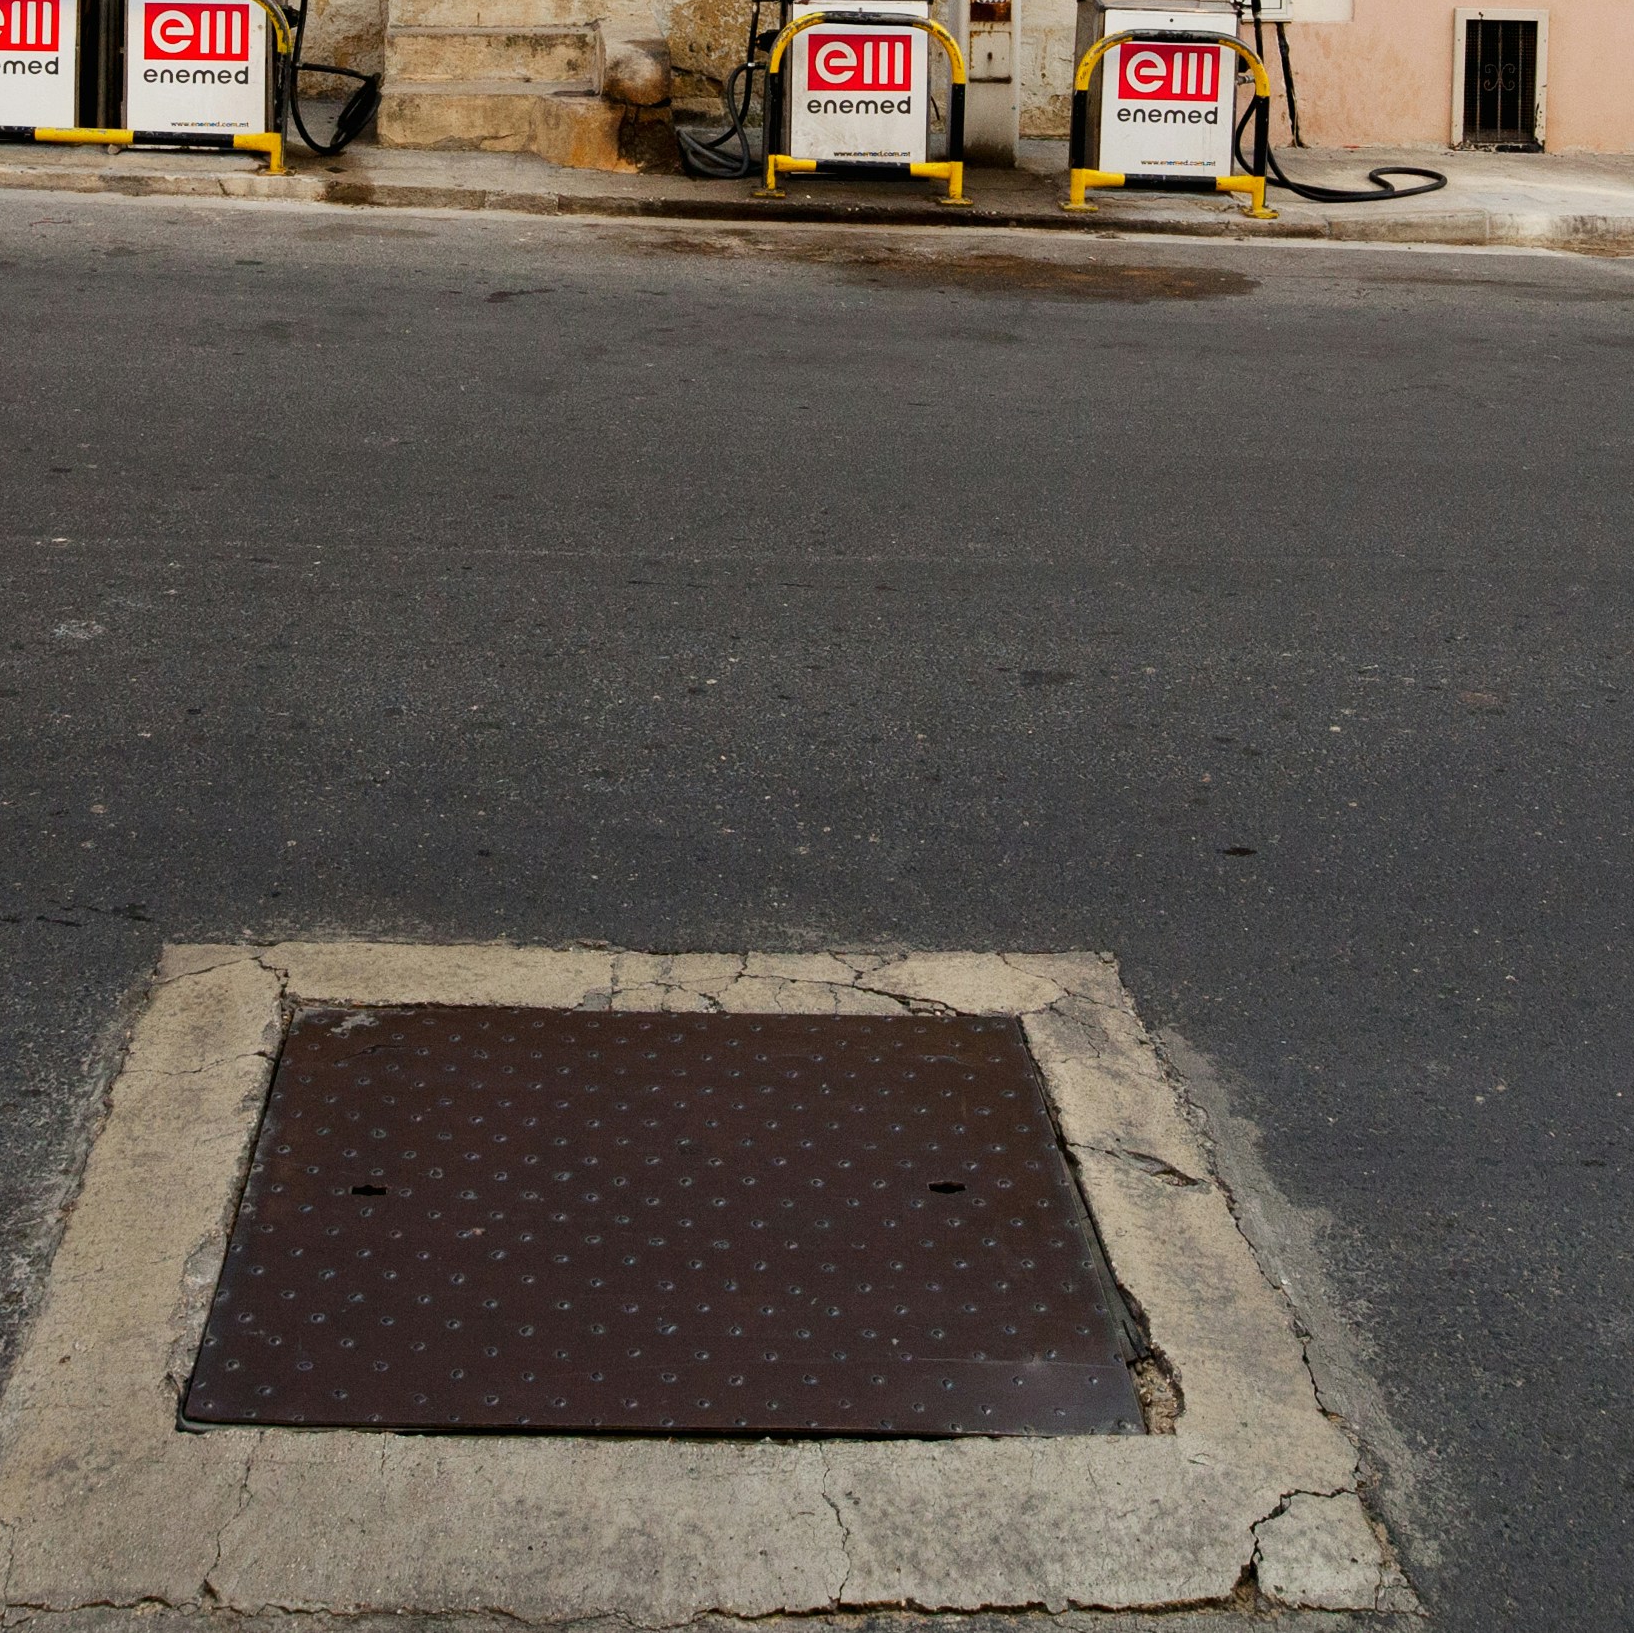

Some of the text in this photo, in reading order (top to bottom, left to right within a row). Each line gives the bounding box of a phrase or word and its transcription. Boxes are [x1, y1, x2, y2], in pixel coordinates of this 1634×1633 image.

[143, 66, 249, 85] enemed
[807, 95, 911, 115] enemed
[1117, 106, 1218, 125] enemed
